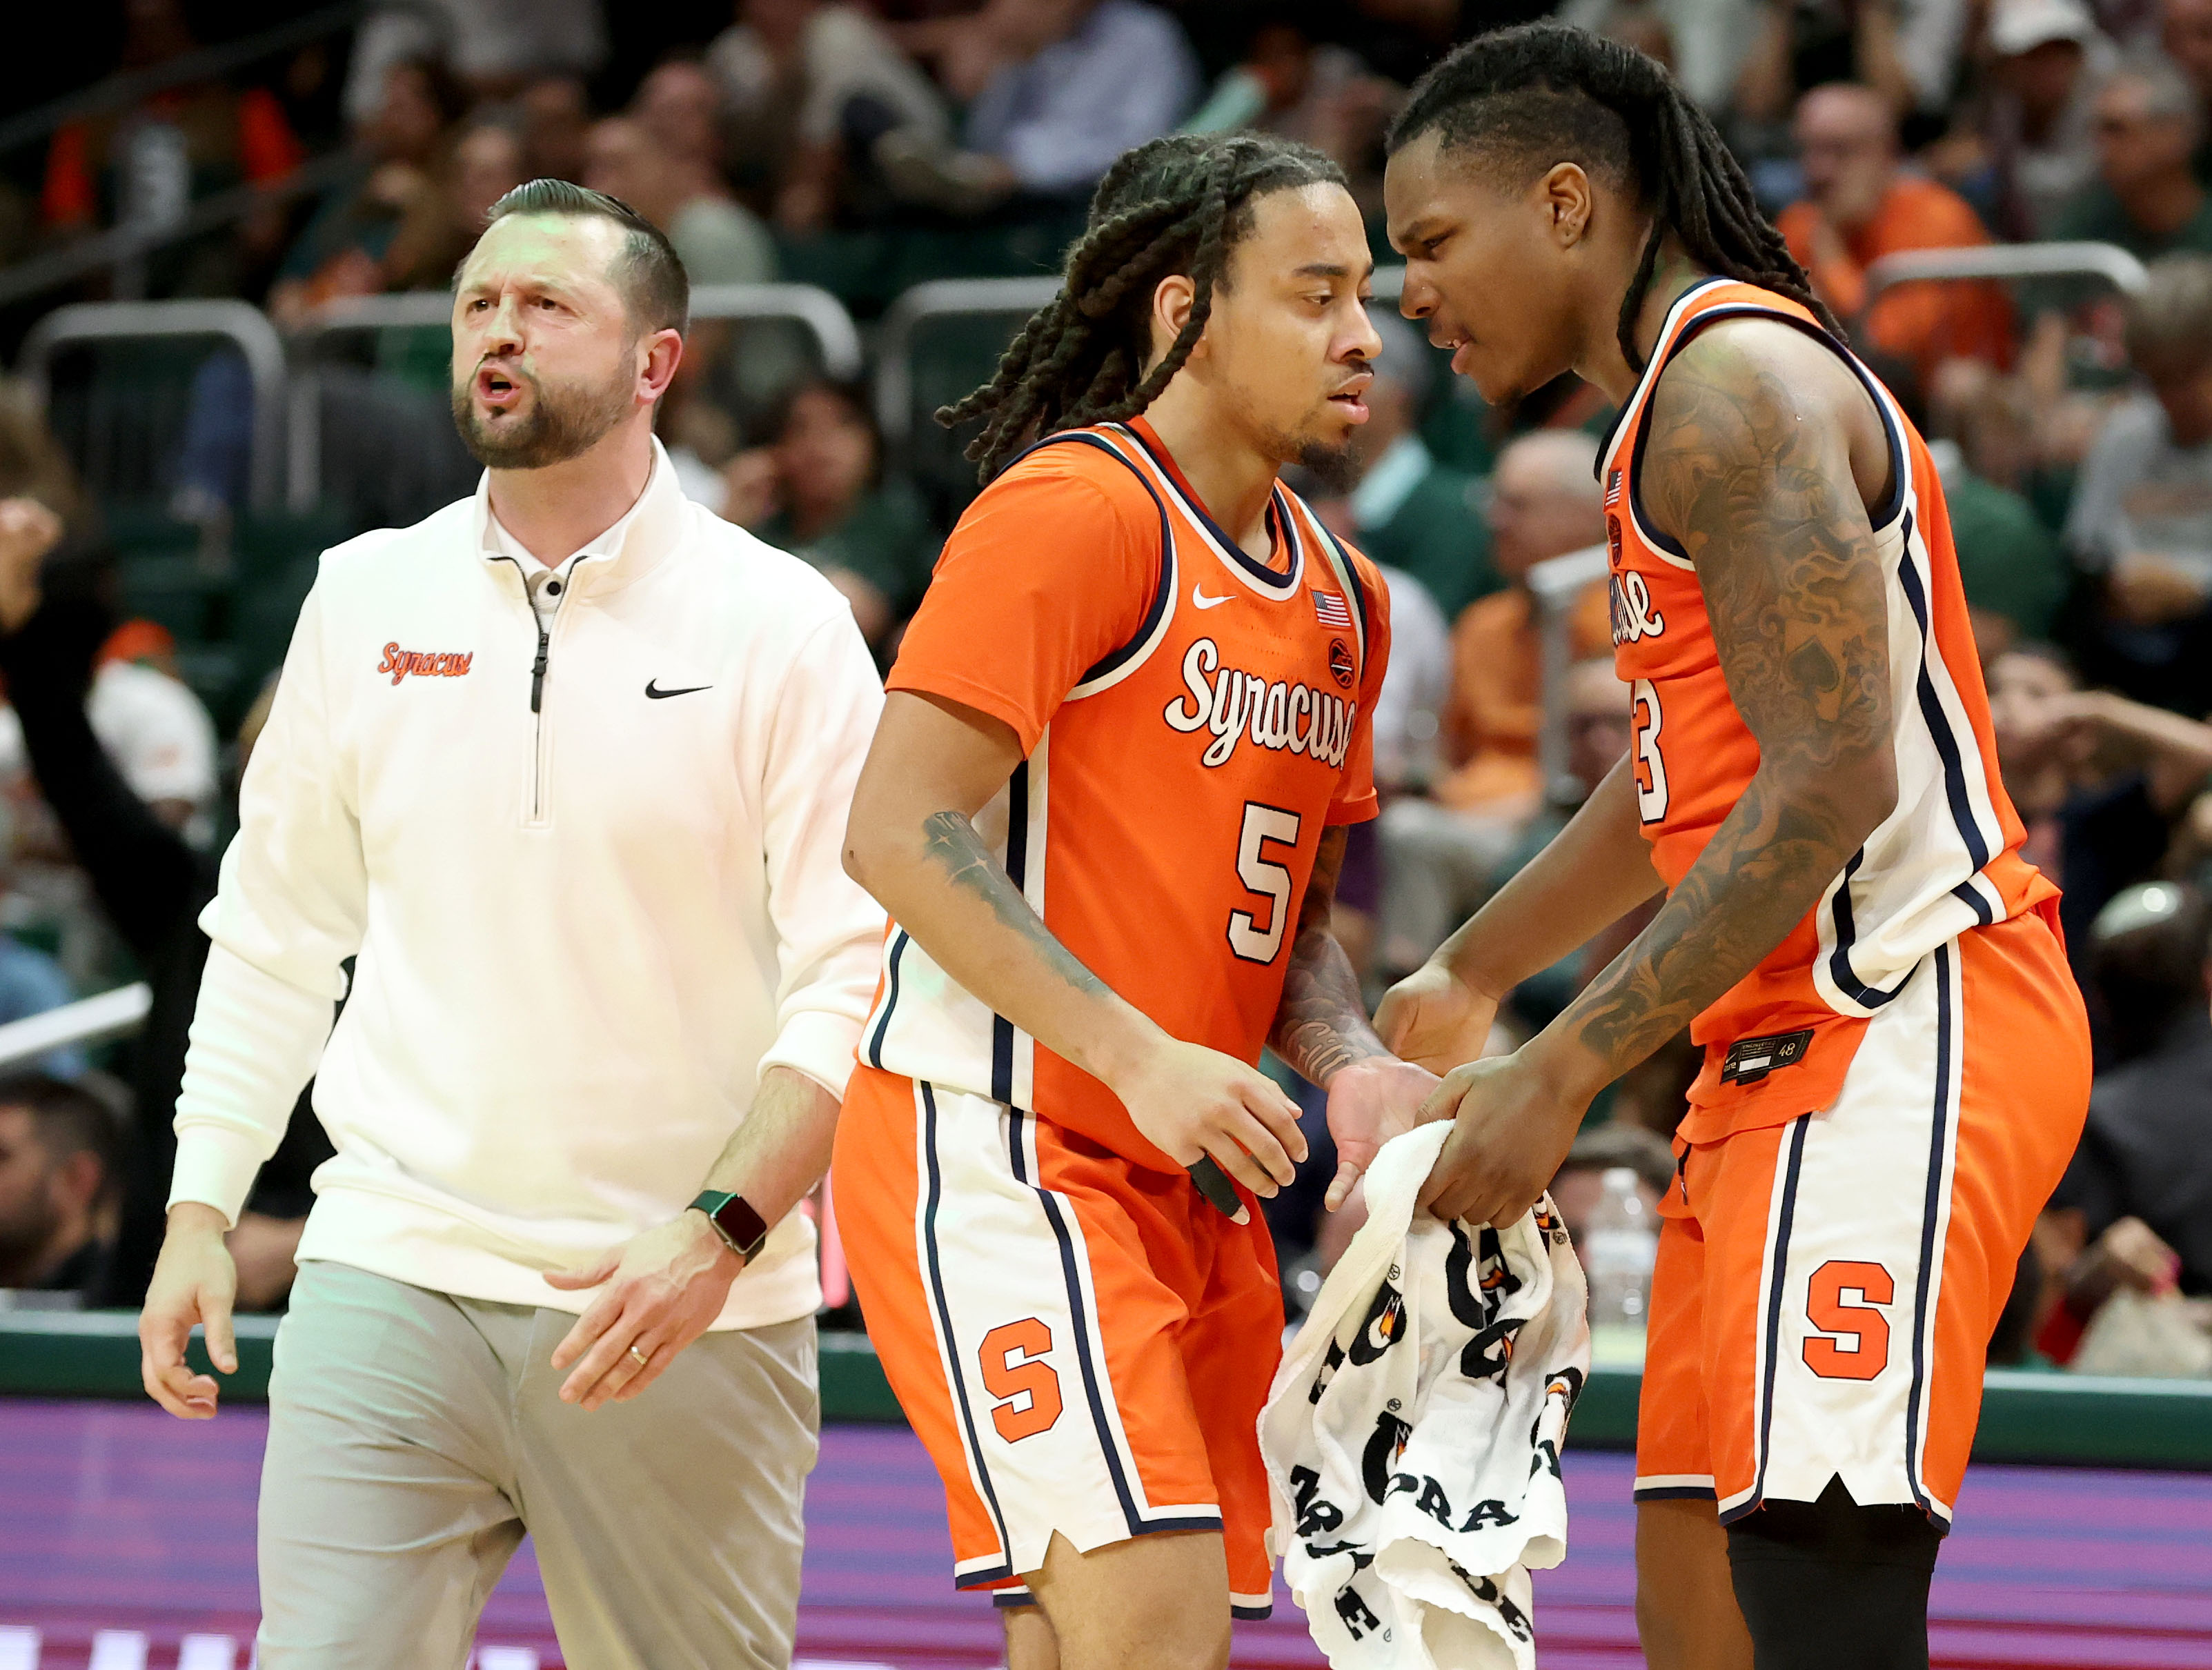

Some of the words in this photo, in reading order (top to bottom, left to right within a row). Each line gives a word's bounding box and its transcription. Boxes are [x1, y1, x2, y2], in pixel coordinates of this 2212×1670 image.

[1225, 801, 1302, 965] 5
[1778, 1042, 1796, 1057] 48
[978, 1317, 1063, 1444] S
[1802, 1260, 1895, 1381] S
